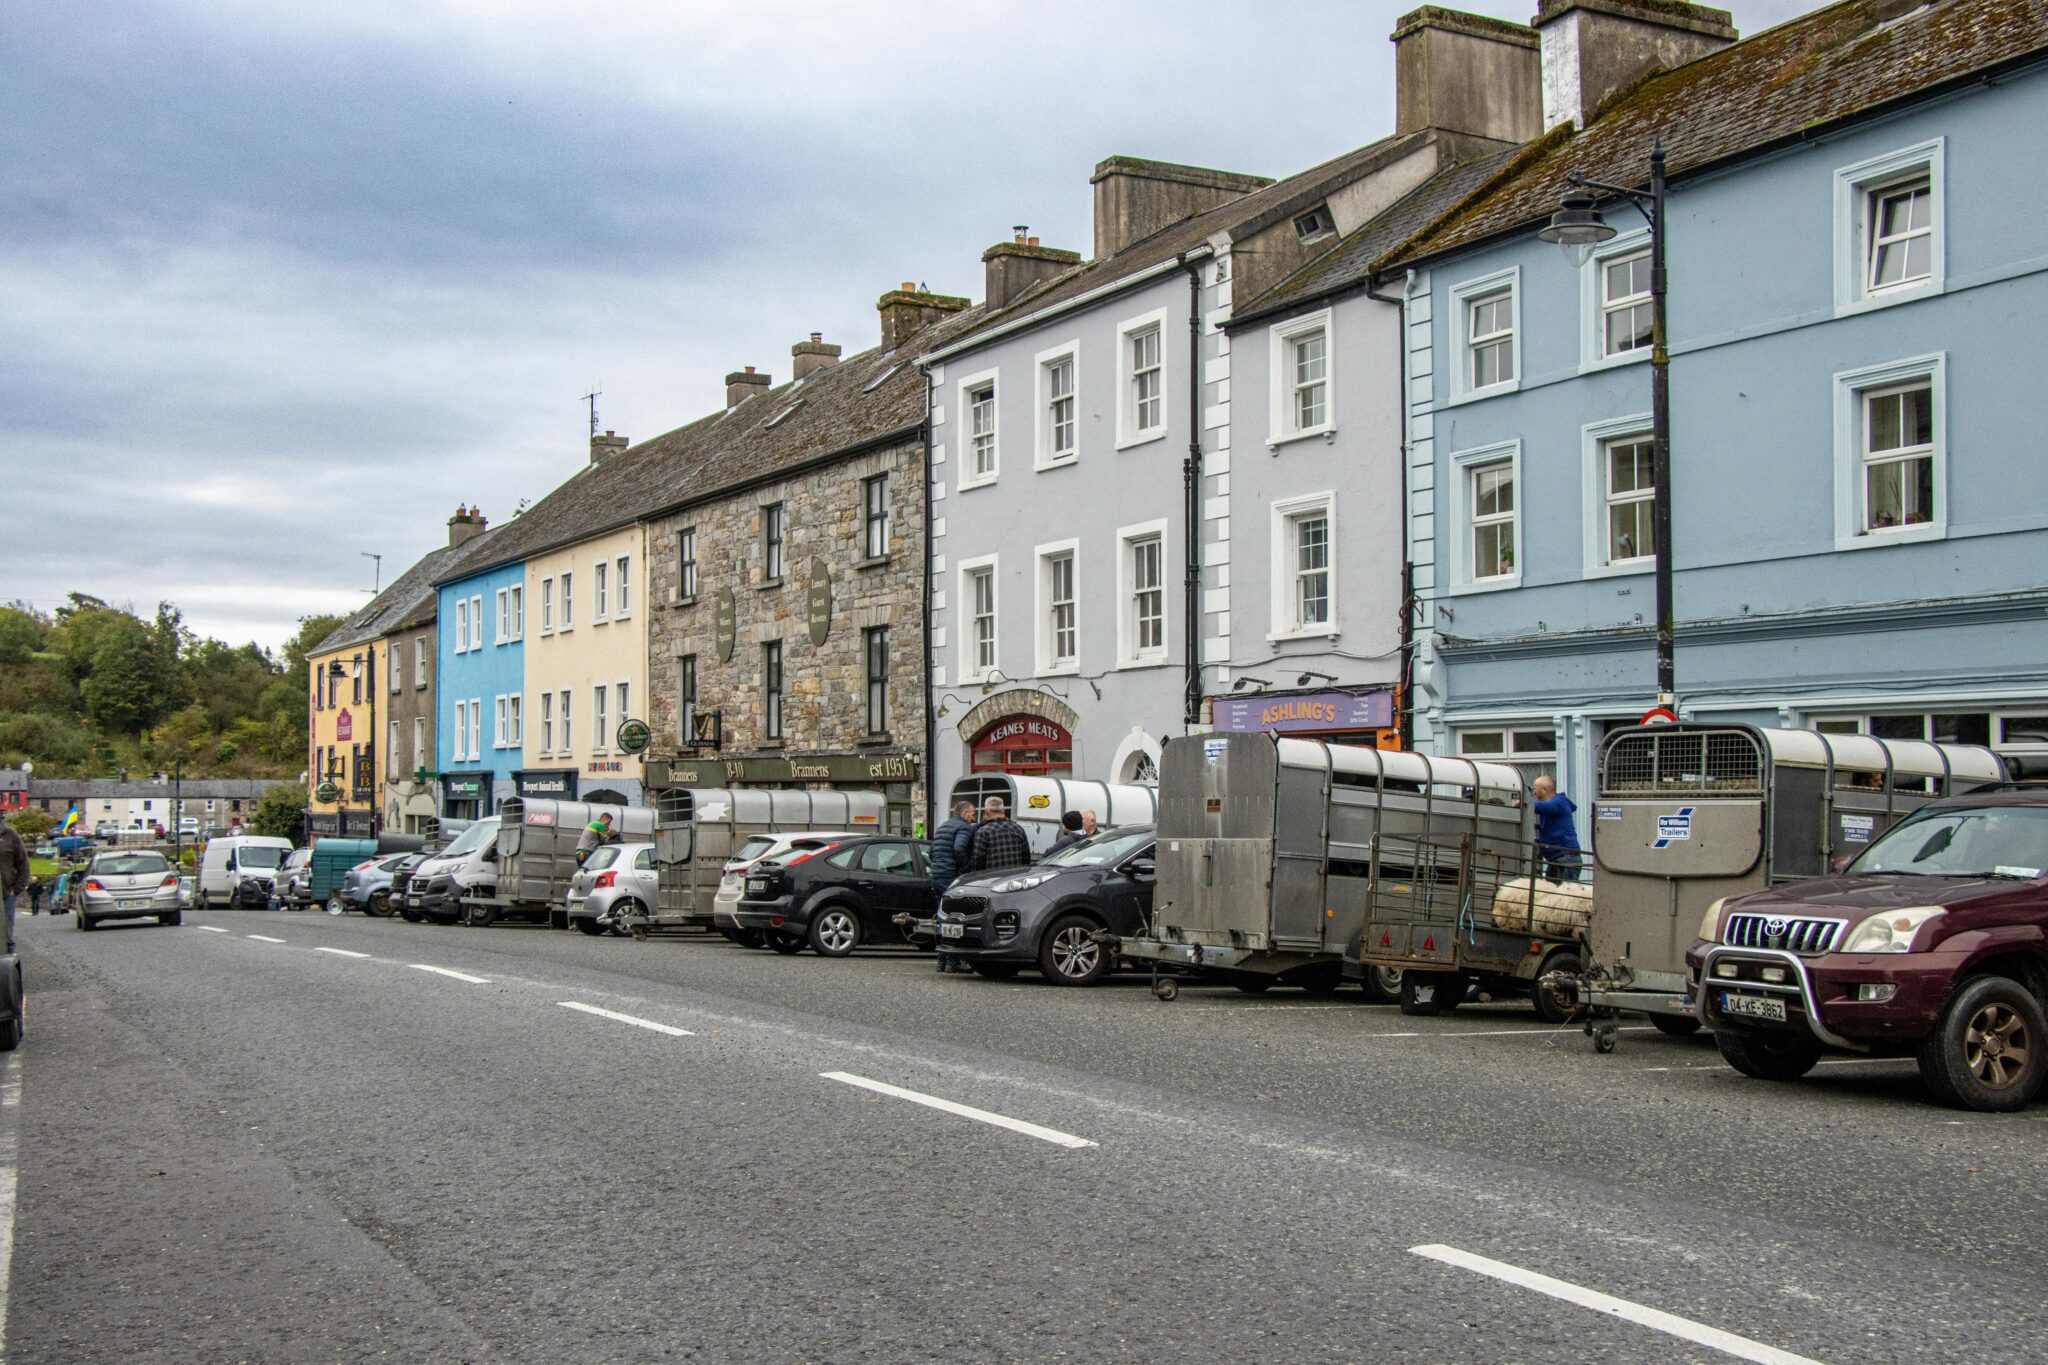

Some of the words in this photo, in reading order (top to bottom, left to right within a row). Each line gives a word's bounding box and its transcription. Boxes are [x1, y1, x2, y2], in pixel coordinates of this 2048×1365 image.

[812, 598, 824, 607] Guest
[811, 613, 827, 623] Rooms
[1261, 701, 1335, 726] ASHLING'S
[990, 722, 1025, 744] KEANES
[1027, 721, 1059, 741] MEATS
[668, 767, 698, 782] Brannens
[726, 761, 745, 778] 8-10
[790, 760, 829, 778] Brannens
[869, 763, 884, 777] est
[885, 758, 908, 777] 1951
[1661, 828, 1688, 836] Trailers
[1730, 998, 1784, 1018] 04-KE-3862
